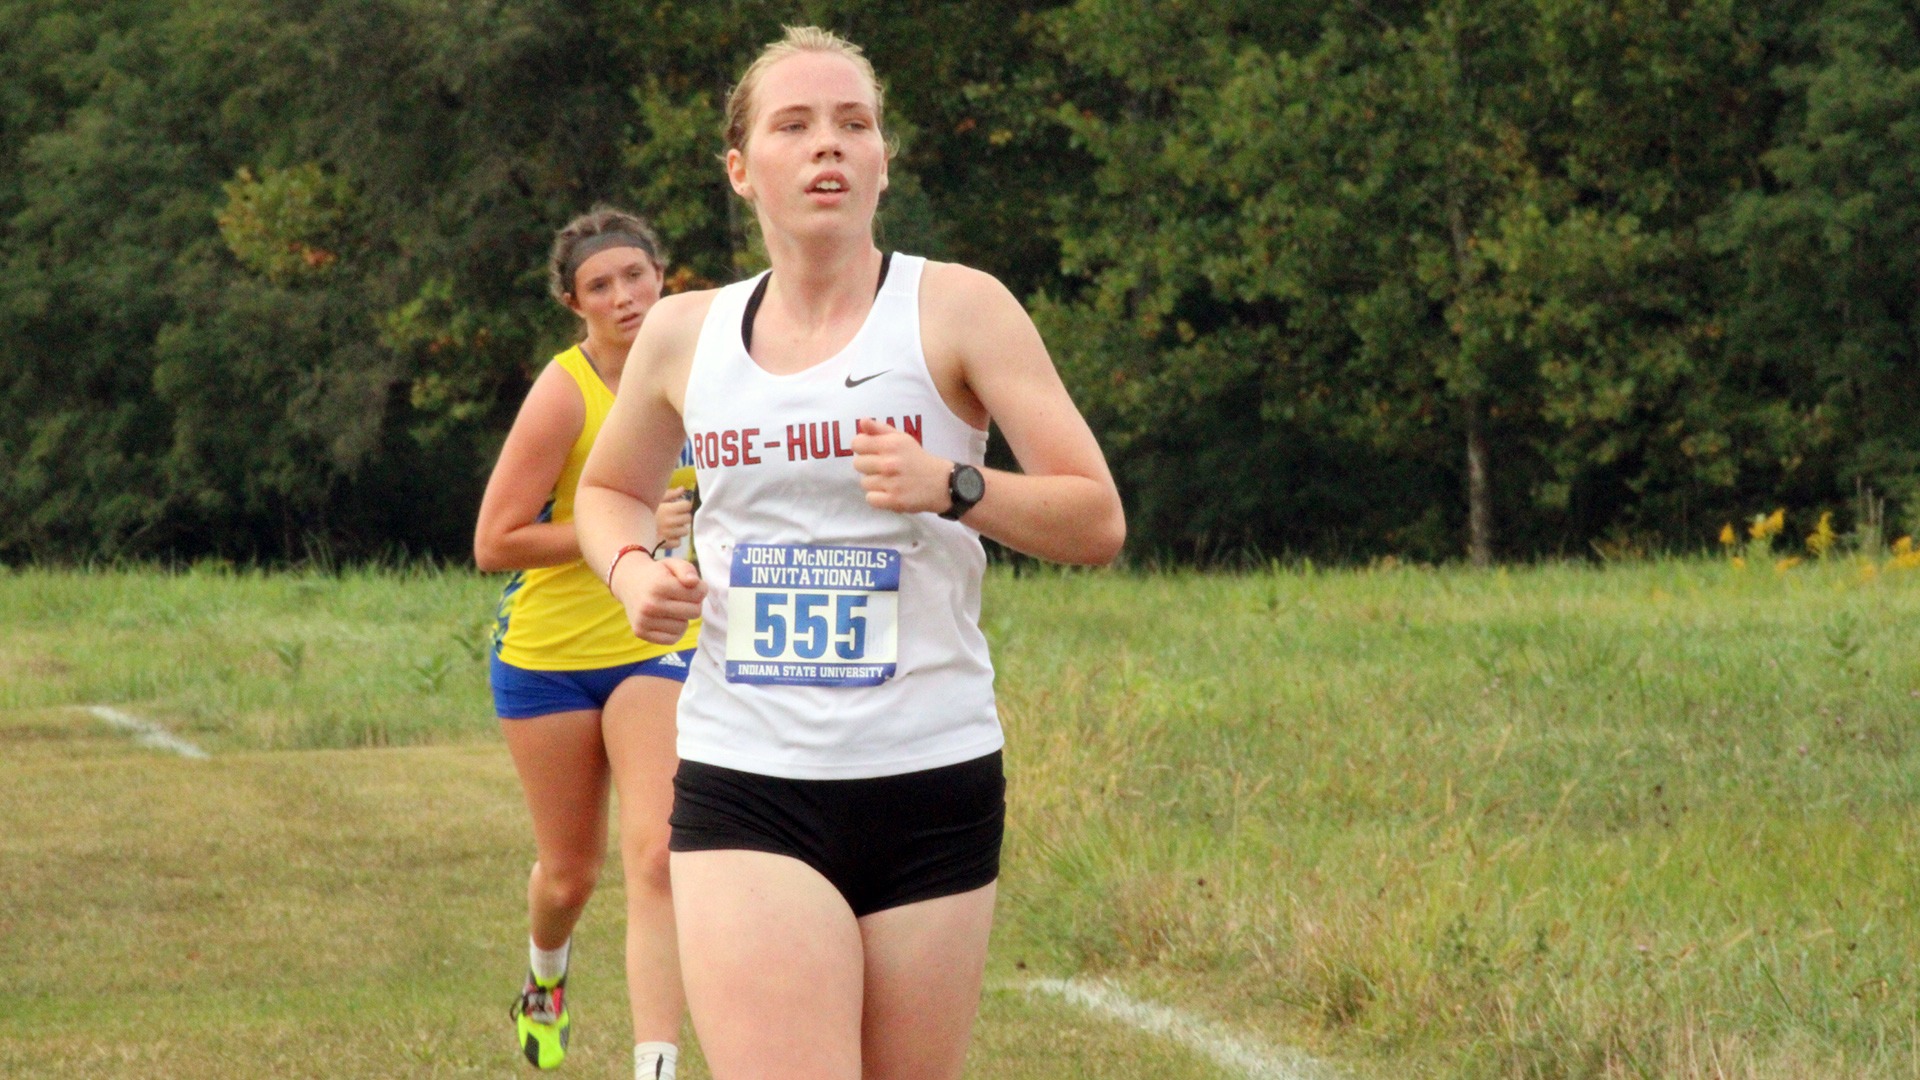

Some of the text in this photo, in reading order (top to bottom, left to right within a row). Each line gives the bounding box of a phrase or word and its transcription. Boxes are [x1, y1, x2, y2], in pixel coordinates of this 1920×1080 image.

[742, 547, 887, 569] JOHN McNICHOLS
[751, 567, 875, 587] INVITATIONAL
[753, 592, 869, 660] 555
[738, 664, 884, 678] INDIANA STATE UNIVERSITY
